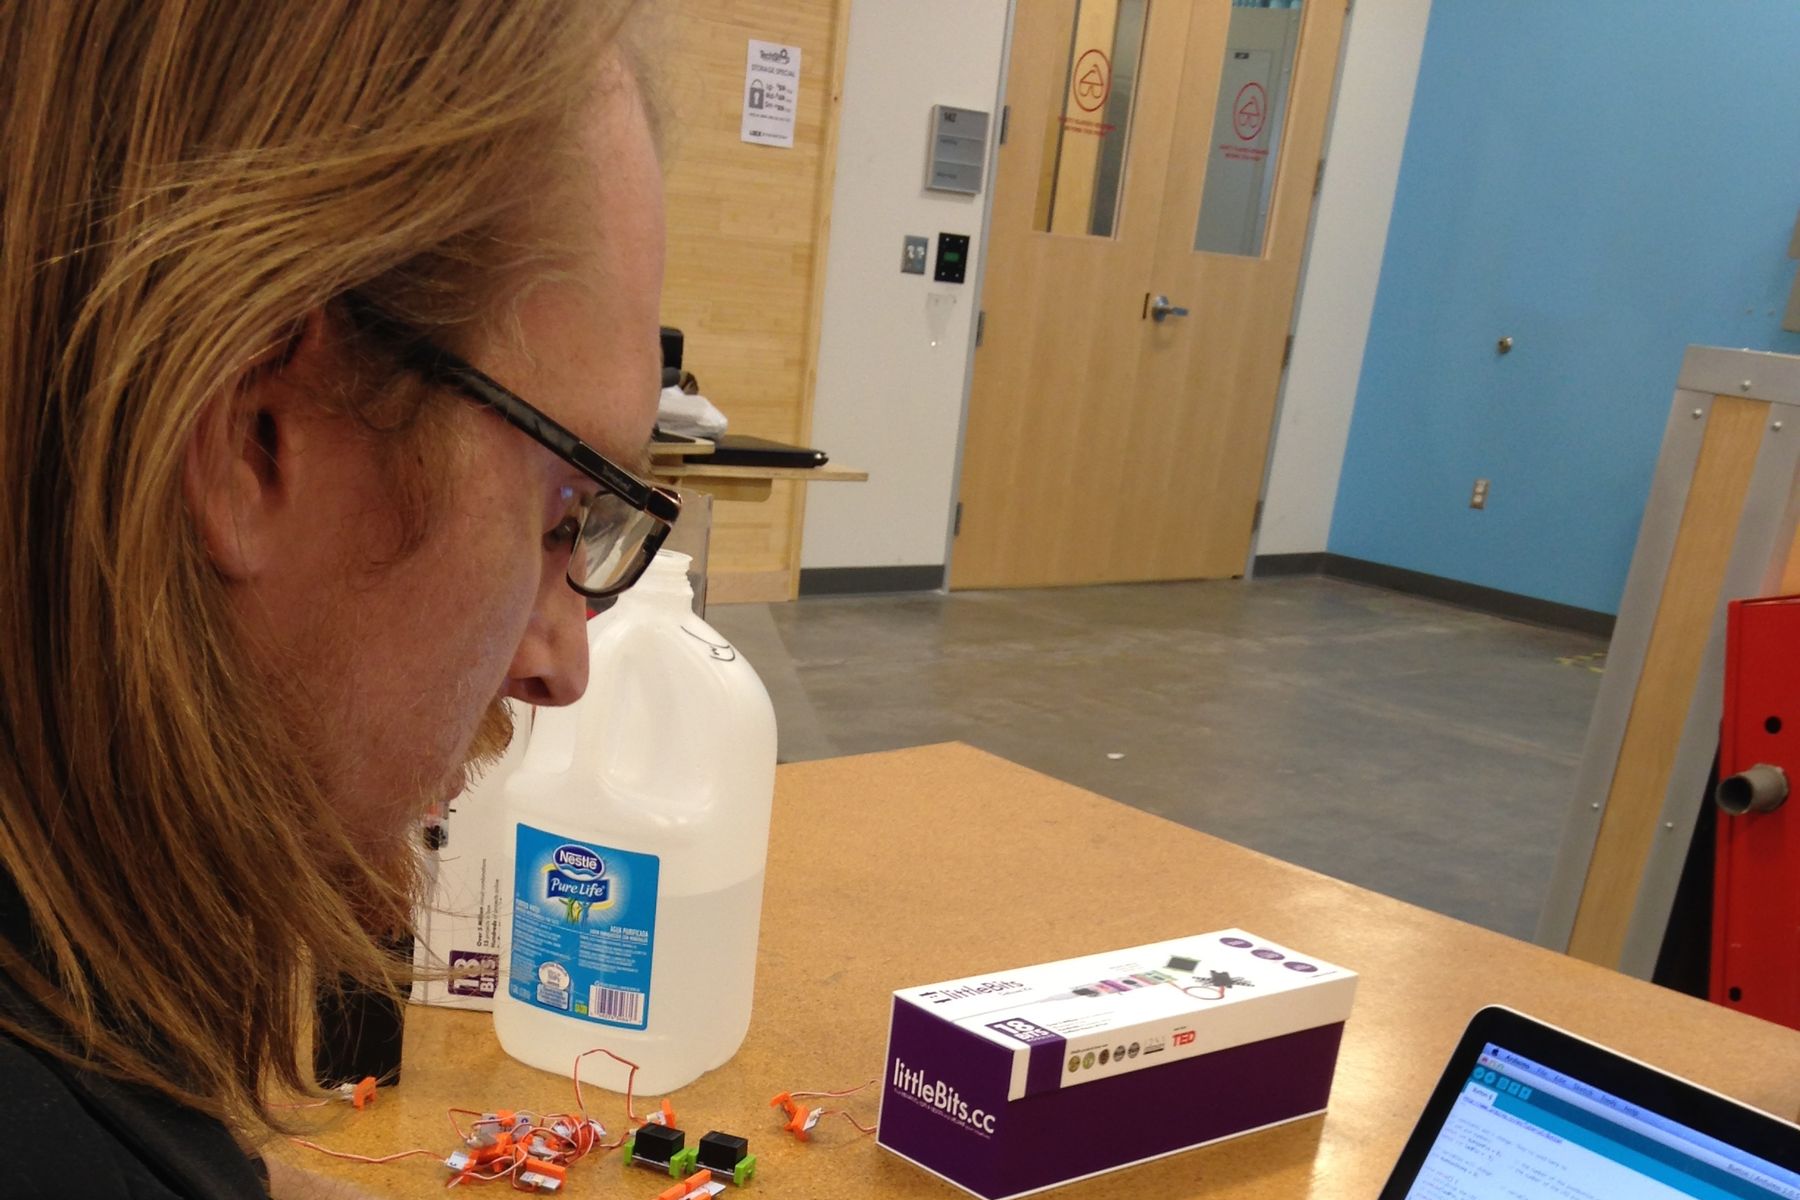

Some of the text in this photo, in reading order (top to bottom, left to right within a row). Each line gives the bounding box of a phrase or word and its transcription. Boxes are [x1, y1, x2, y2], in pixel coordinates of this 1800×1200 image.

[550, 878, 578, 894] Pure
[939, 980, 1025, 1000] littleBits
[993, 1020, 1035, 1035] 18
[1172, 1030, 1196, 1047] TED
[893, 1057, 996, 1134] littleBits.cc
